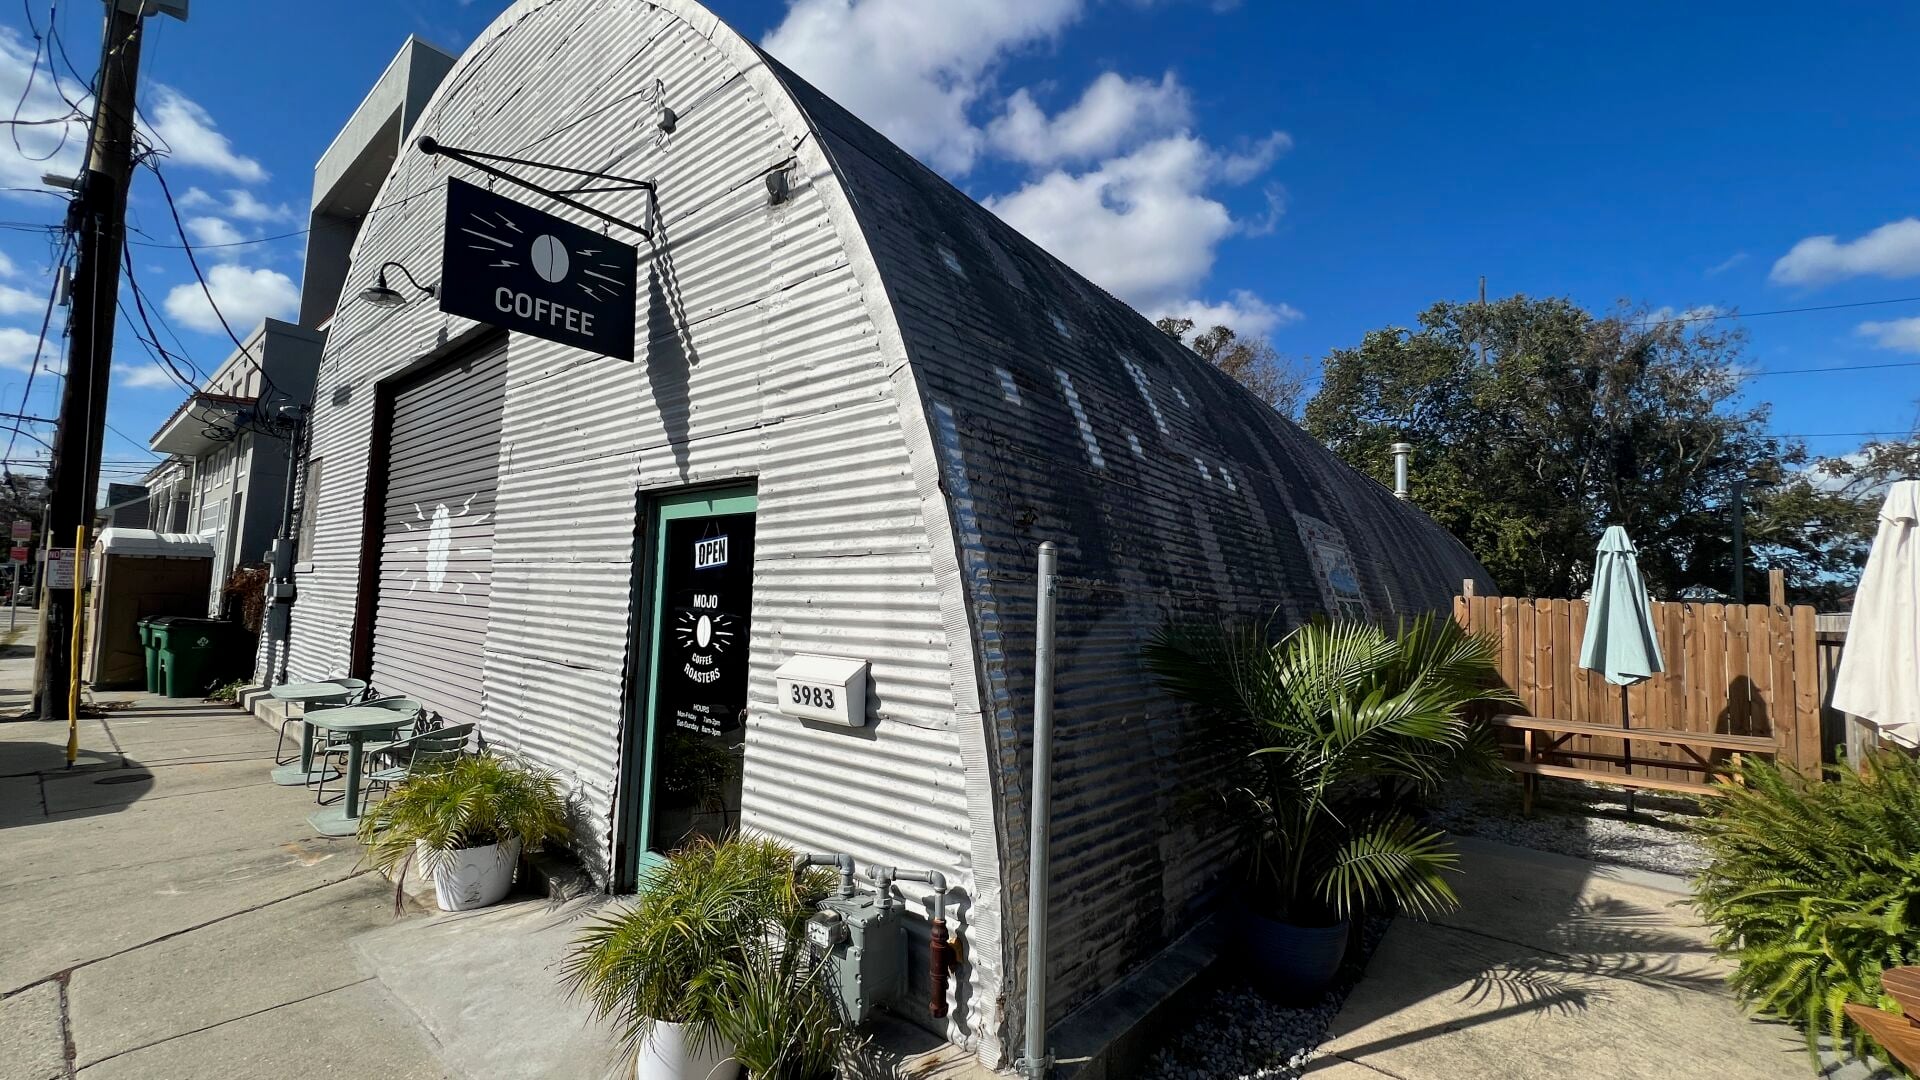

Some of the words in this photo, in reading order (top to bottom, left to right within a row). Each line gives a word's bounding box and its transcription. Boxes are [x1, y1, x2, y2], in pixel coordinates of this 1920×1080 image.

[495, 286, 595, 336] COFFEE
[49, 551, 60, 559] NO
[698, 539, 726, 566] OPEN
[693, 594, 718, 608] MOJO
[692, 653, 713, 665] COFFEE
[684, 663, 720, 683] ROASTERS
[792, 684, 835, 709] 3983
[693, 704, 710, 713] HOURS
